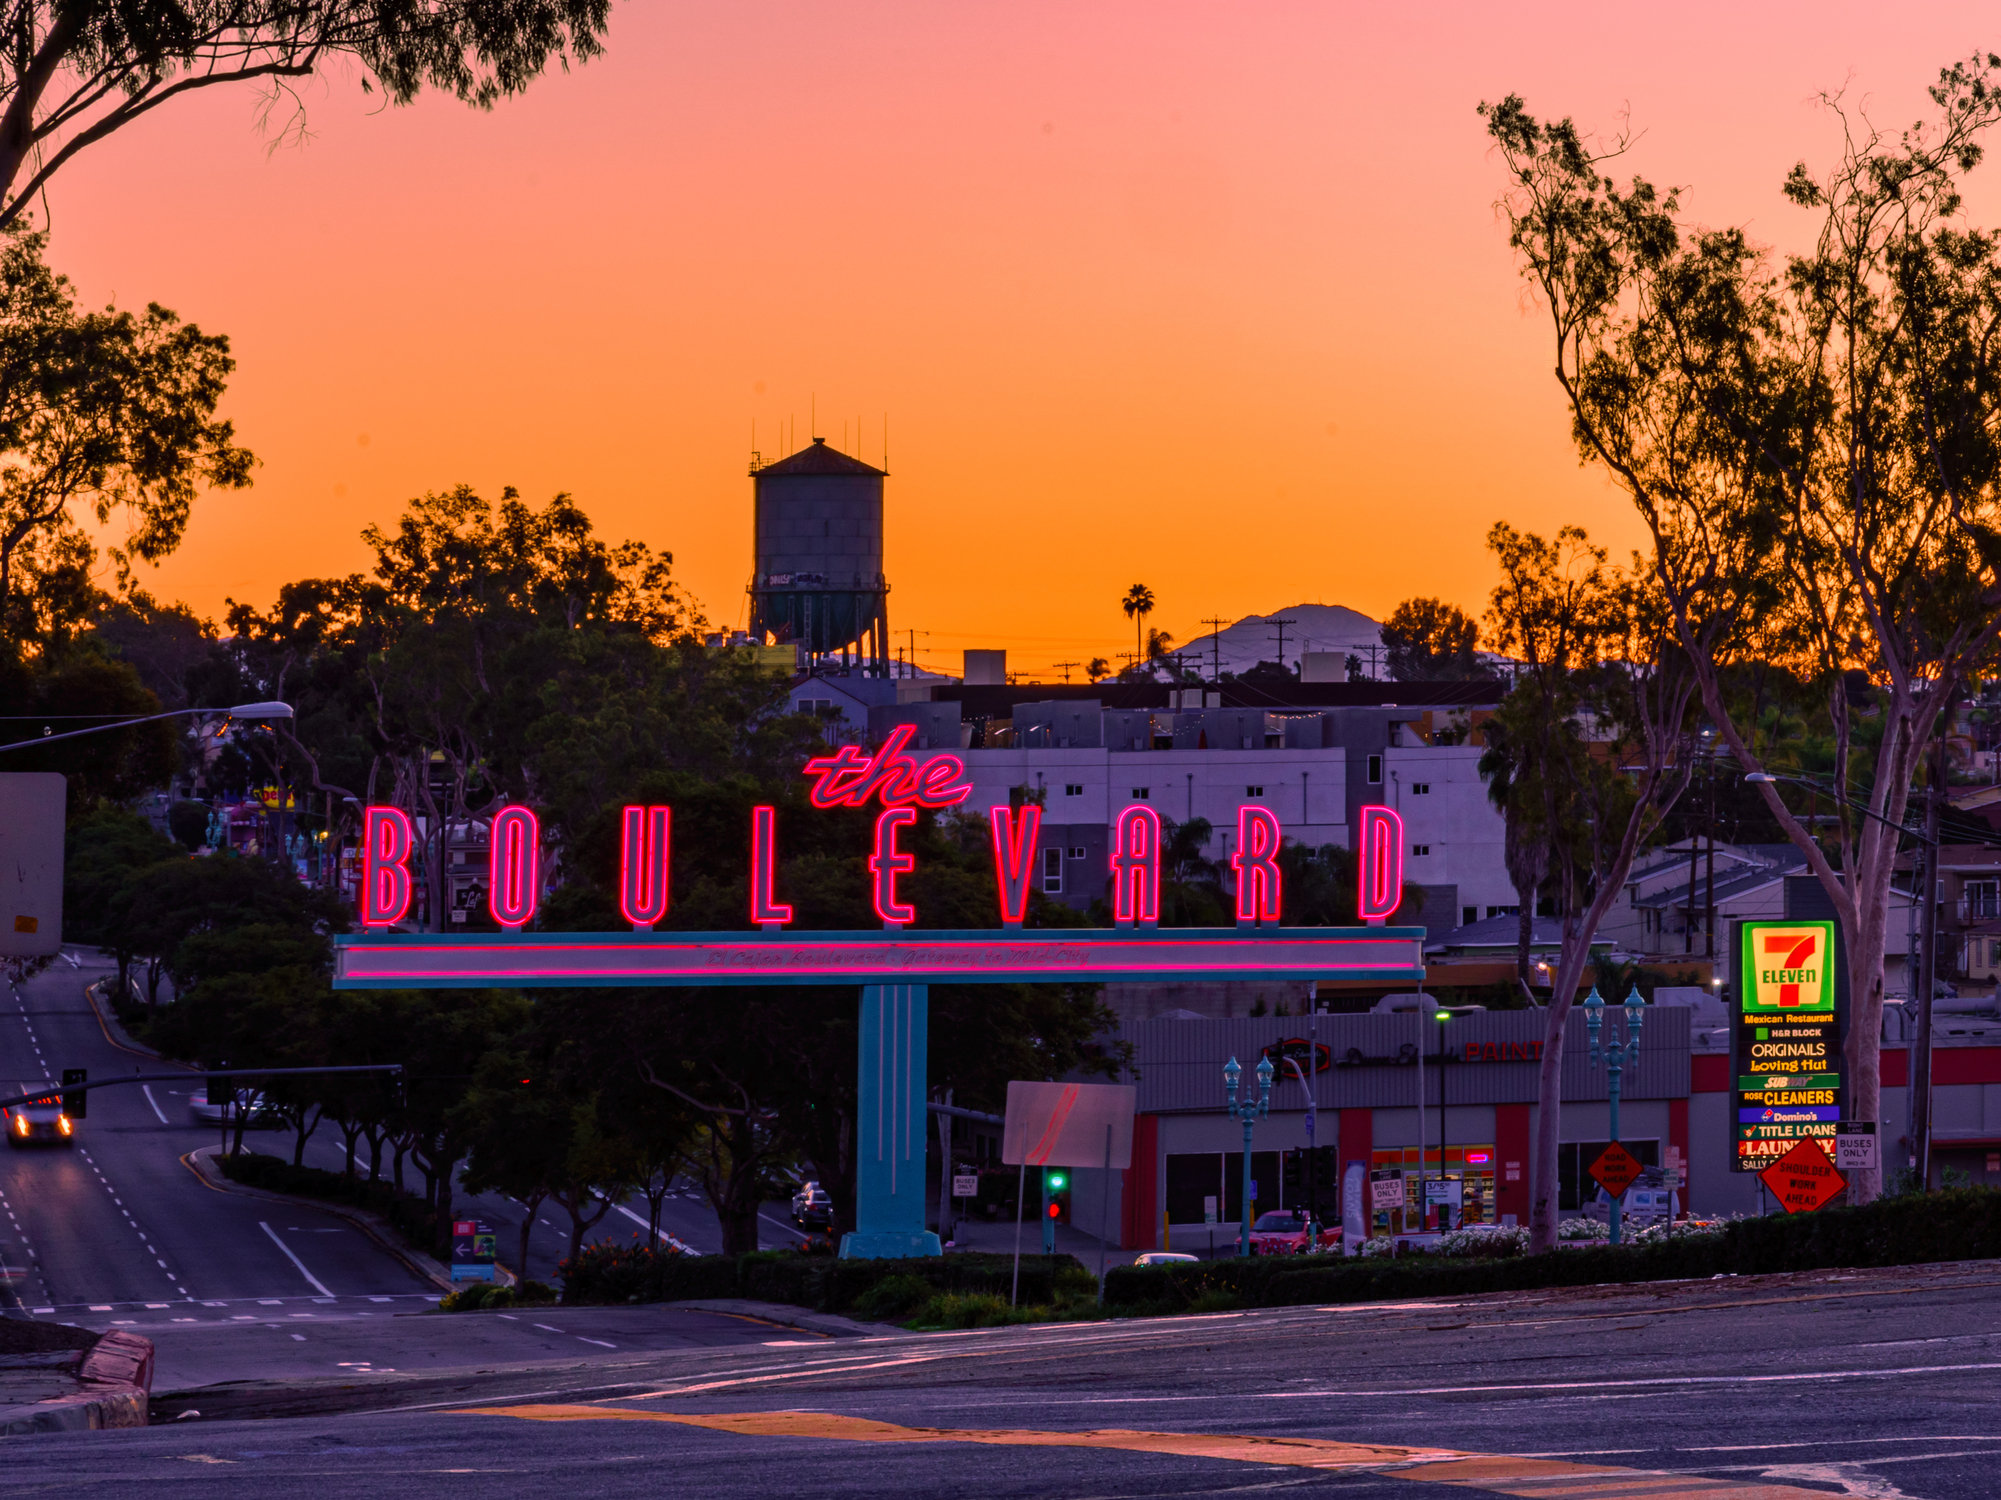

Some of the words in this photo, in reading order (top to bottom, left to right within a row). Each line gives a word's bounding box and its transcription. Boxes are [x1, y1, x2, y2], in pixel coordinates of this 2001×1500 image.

[803, 723, 974, 808] the
[362, 805, 1405, 927] BOULEVARD
[1744, 1014, 1783, 1024] Mexican
[1786, 1014, 1834, 1023] Restaurant
[1771, 1029, 1791, 1038] H&R
[1792, 1028, 1822, 1037] BLOCK
[1465, 1041, 1544, 1062] PAINT
[1750, 1060, 1799, 1072] Loving
[1800, 1059, 1827, 1071] Hut
[1764, 1076, 1811, 1089] SUBWAY
[1744, 1092, 1764, 1101] ROSE
[1764, 1090, 1834, 1105] CLEANERS
[1773, 1111, 1818, 1122] Domino's
[1758, 1125, 1793, 1137] TITLE
[1796, 1124, 1836, 1136] LOANS
[1746, 1139, 1834, 1155] LAUNY
[1840, 1139, 1872, 1148] BUSES
[1843, 1149, 1869, 1157] ONLY
[1742, 1160, 1767, 1170] SALLY
[1779, 1162, 1831, 1177] SHOULDER
[1373, 1181, 1400, 1191] BUSES
[1789, 1178, 1816, 1191] WORK
[1376, 1189, 1398, 1198] ONLY
[1785, 1193, 1817, 1206] AHEAD
